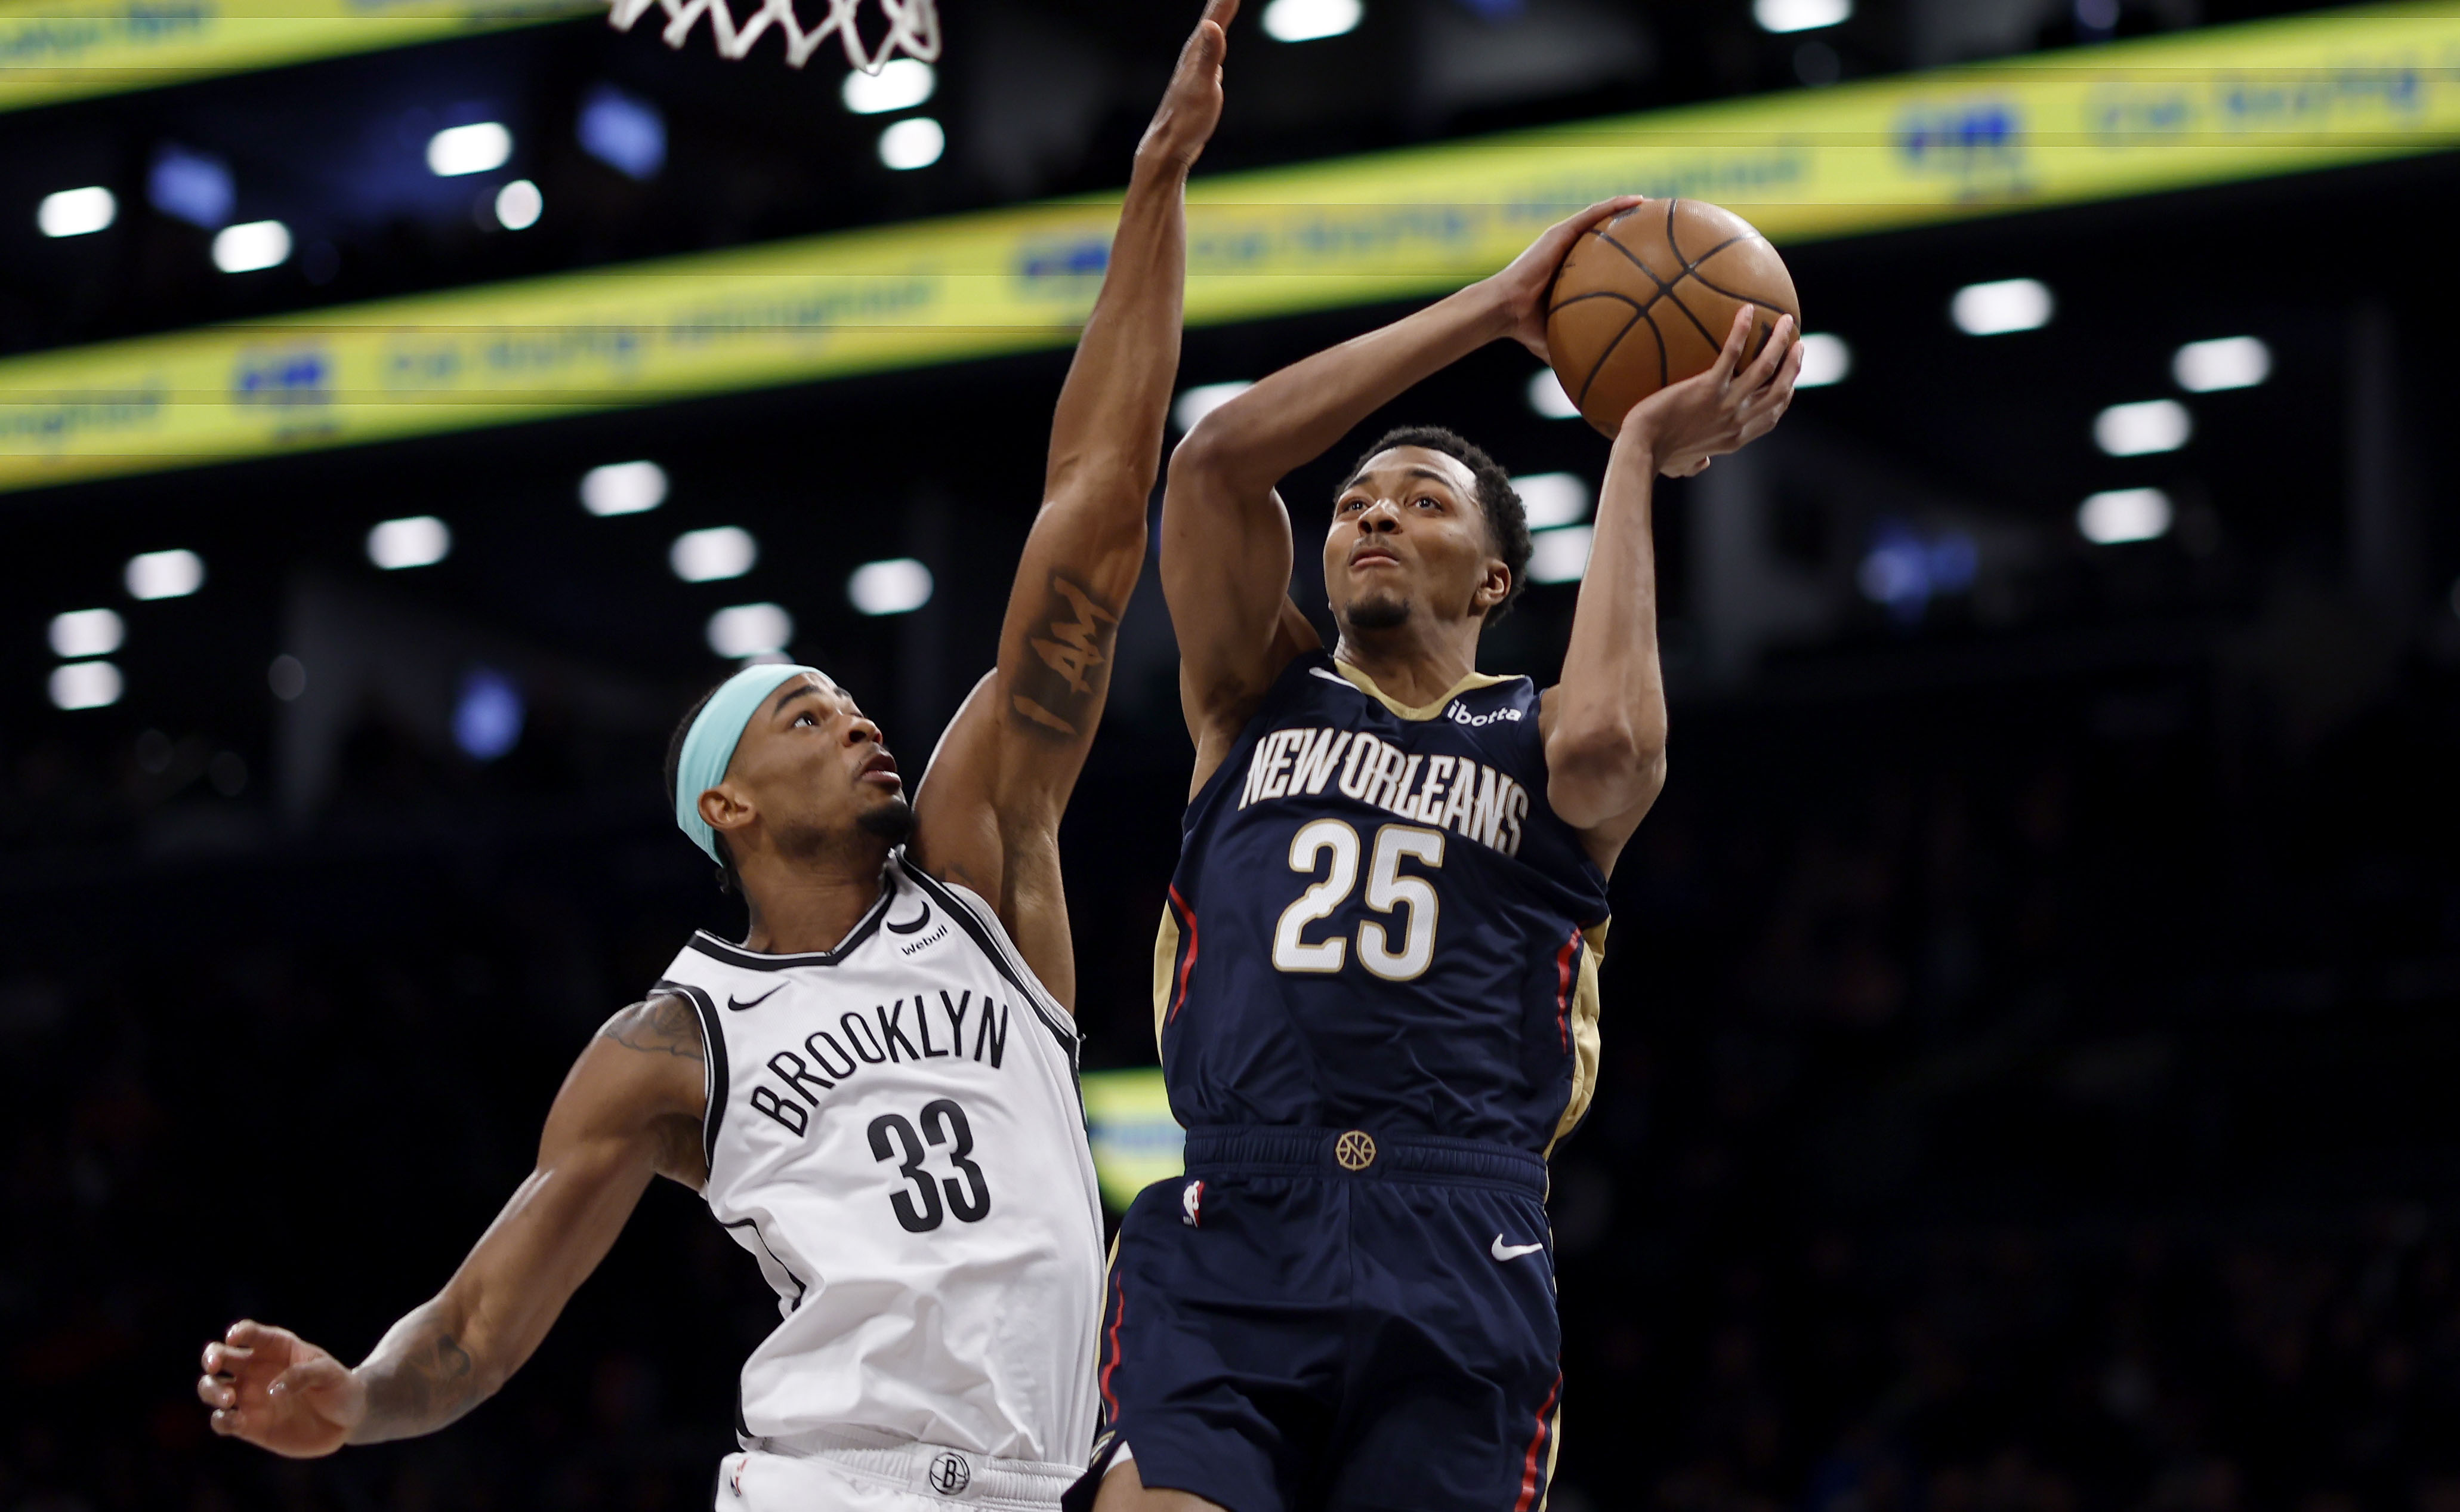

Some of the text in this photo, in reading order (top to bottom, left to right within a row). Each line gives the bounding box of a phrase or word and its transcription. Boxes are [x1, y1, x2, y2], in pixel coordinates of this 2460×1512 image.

[1013, 575, 1119, 736] I AM
[1447, 699, 1521, 727] ibotta
[1237, 727, 1529, 857] NEW ORLEANS
[900, 924, 948, 956] Webull
[1272, 817, 1445, 982] 25
[750, 990, 1008, 1137] BROOKLYN
[867, 1098, 990, 1233] 33
[943, 1459, 957, 1488] B
